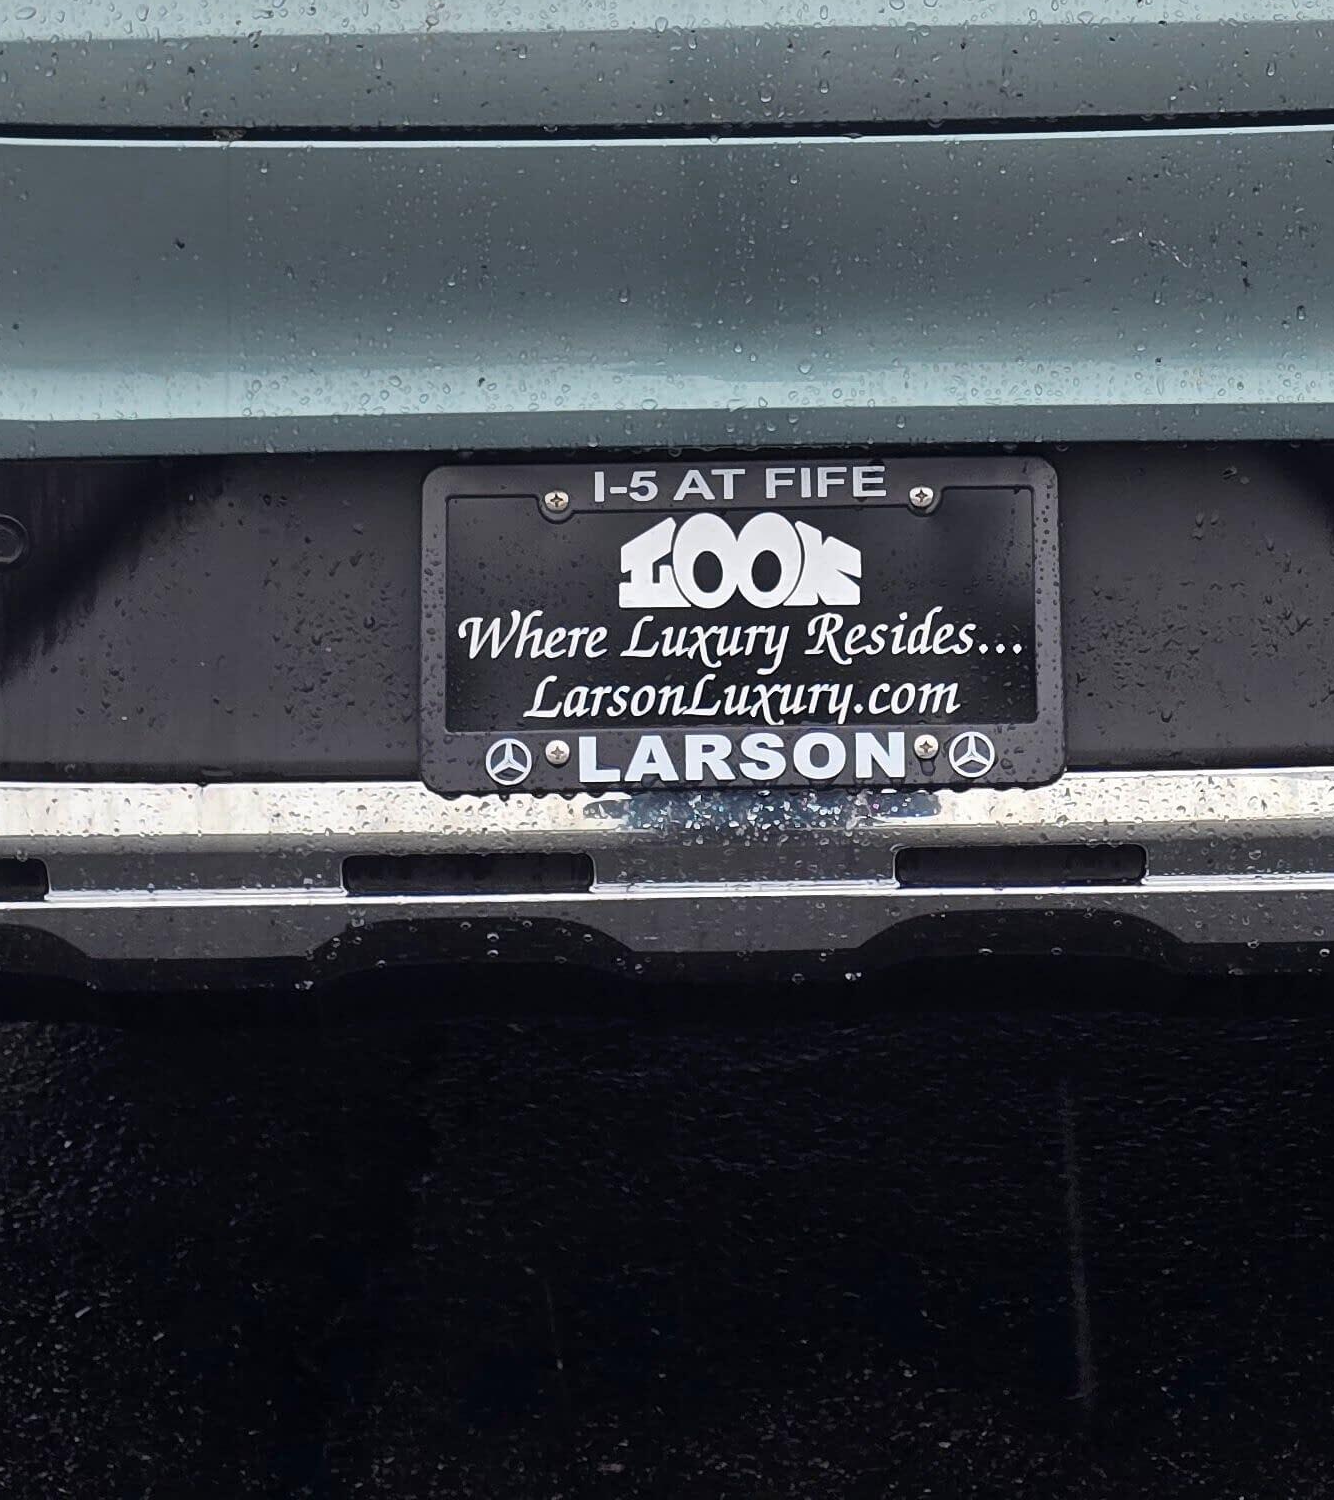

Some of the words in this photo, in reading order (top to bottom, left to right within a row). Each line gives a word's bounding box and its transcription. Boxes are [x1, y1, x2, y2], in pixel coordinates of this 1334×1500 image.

[593, 470, 659, 503] I-5
[672, 468, 746, 501] AT
[765, 465, 887, 499] FIFE
[457, 609, 608, 660] Where
[619, 615, 790, 676] Luxury
[804, 605, 1023, 666] Resides...
[522, 673, 961, 726] LarsonLuxury.com
[578, 731, 906, 783] LARSON
